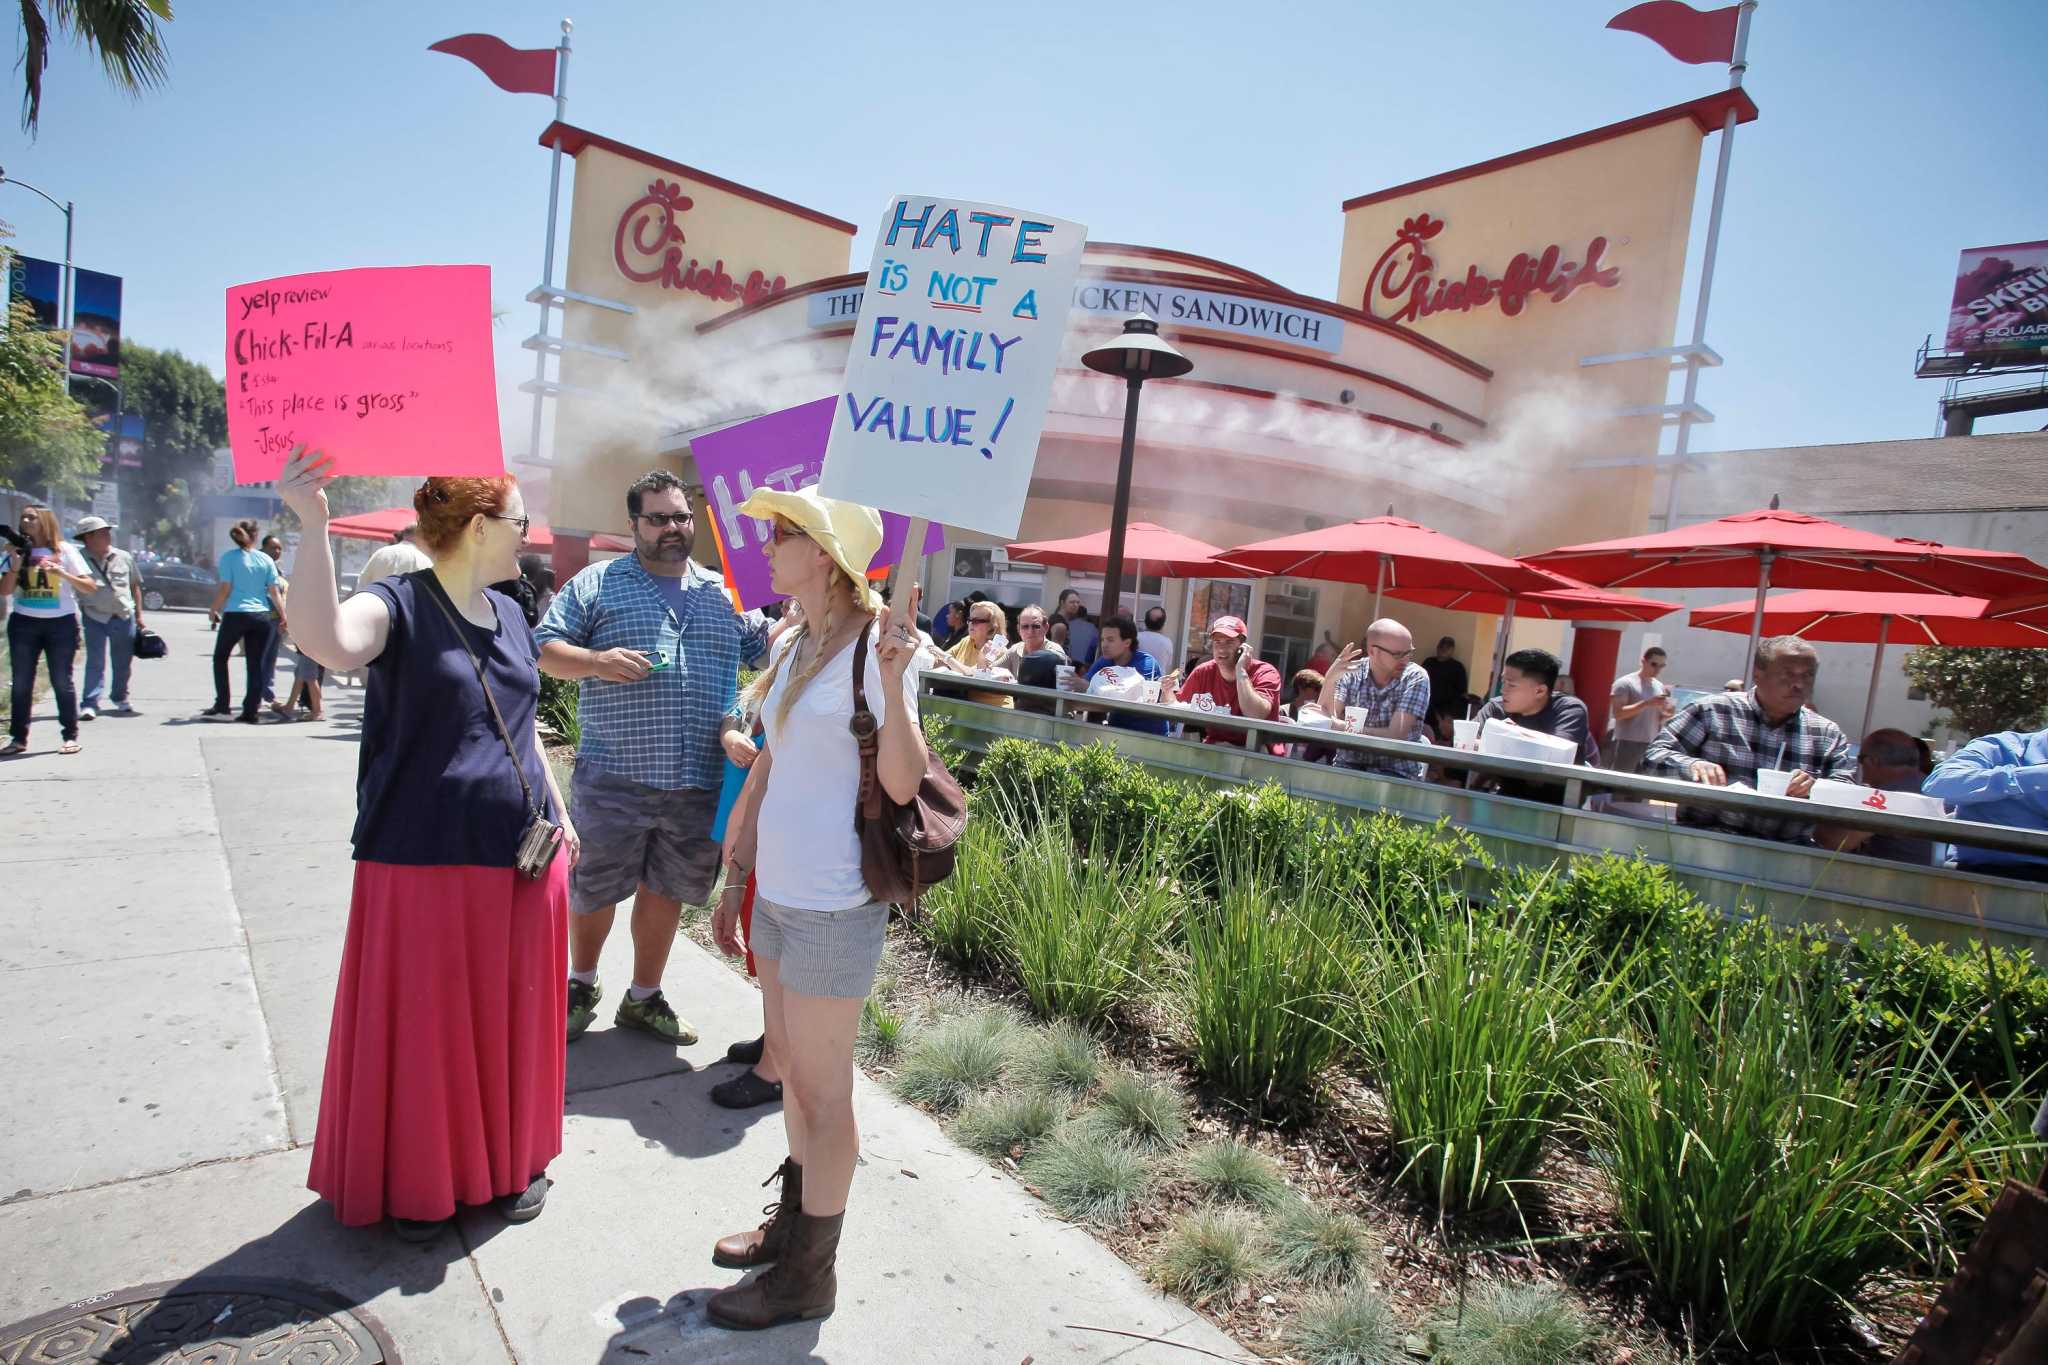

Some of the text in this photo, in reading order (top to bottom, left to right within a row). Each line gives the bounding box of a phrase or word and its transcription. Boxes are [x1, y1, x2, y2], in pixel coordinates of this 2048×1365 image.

[884, 200, 1055, 265] HATE
[1362, 212, 1621, 323] Chick-fil-A
[240, 286, 332, 320] yelp review
[927, 270, 999, 306] NOT
[1012, 288, 1038, 319] A
[1171, 294, 1322, 342] SANDWICH
[282, 391, 324, 420] place
[335, 394, 349, 410] is
